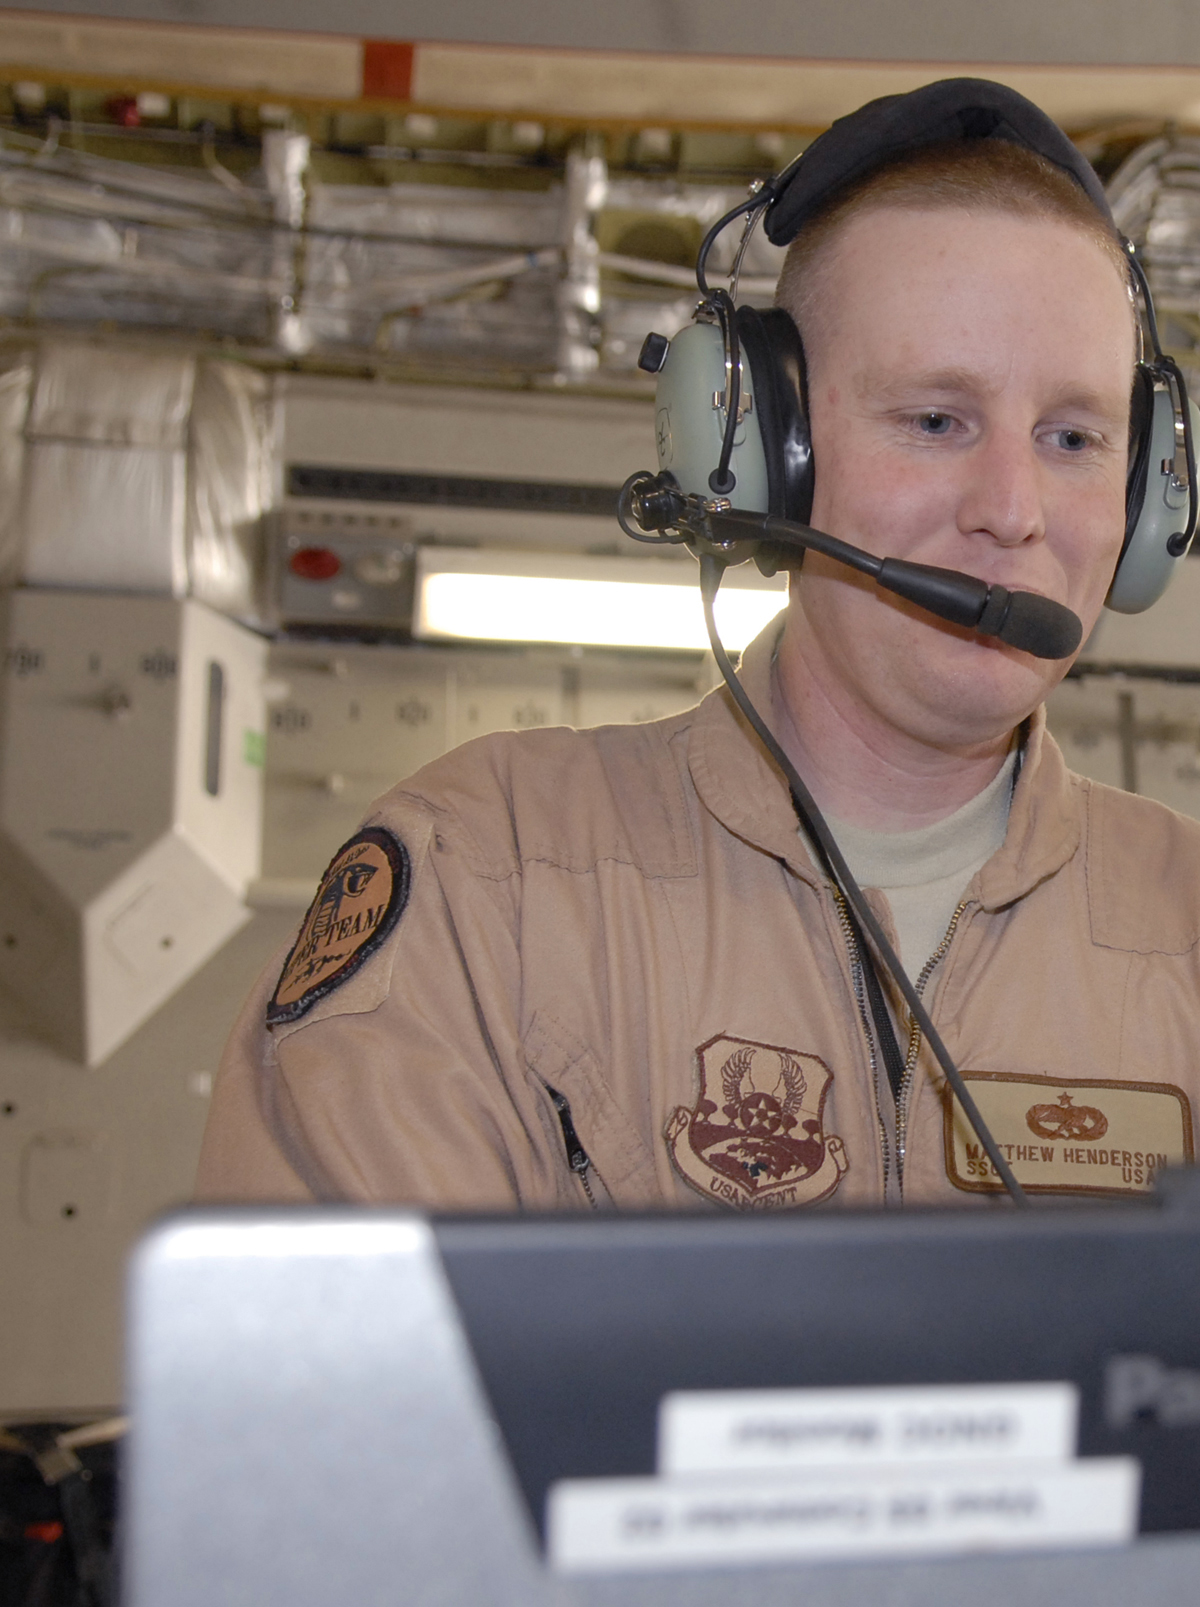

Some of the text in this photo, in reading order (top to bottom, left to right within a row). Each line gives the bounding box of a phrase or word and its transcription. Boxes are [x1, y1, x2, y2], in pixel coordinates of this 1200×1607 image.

[324, 903, 386, 947] TEAM
[965, 1143, 1168, 1170] MTHEW HENDERSON
